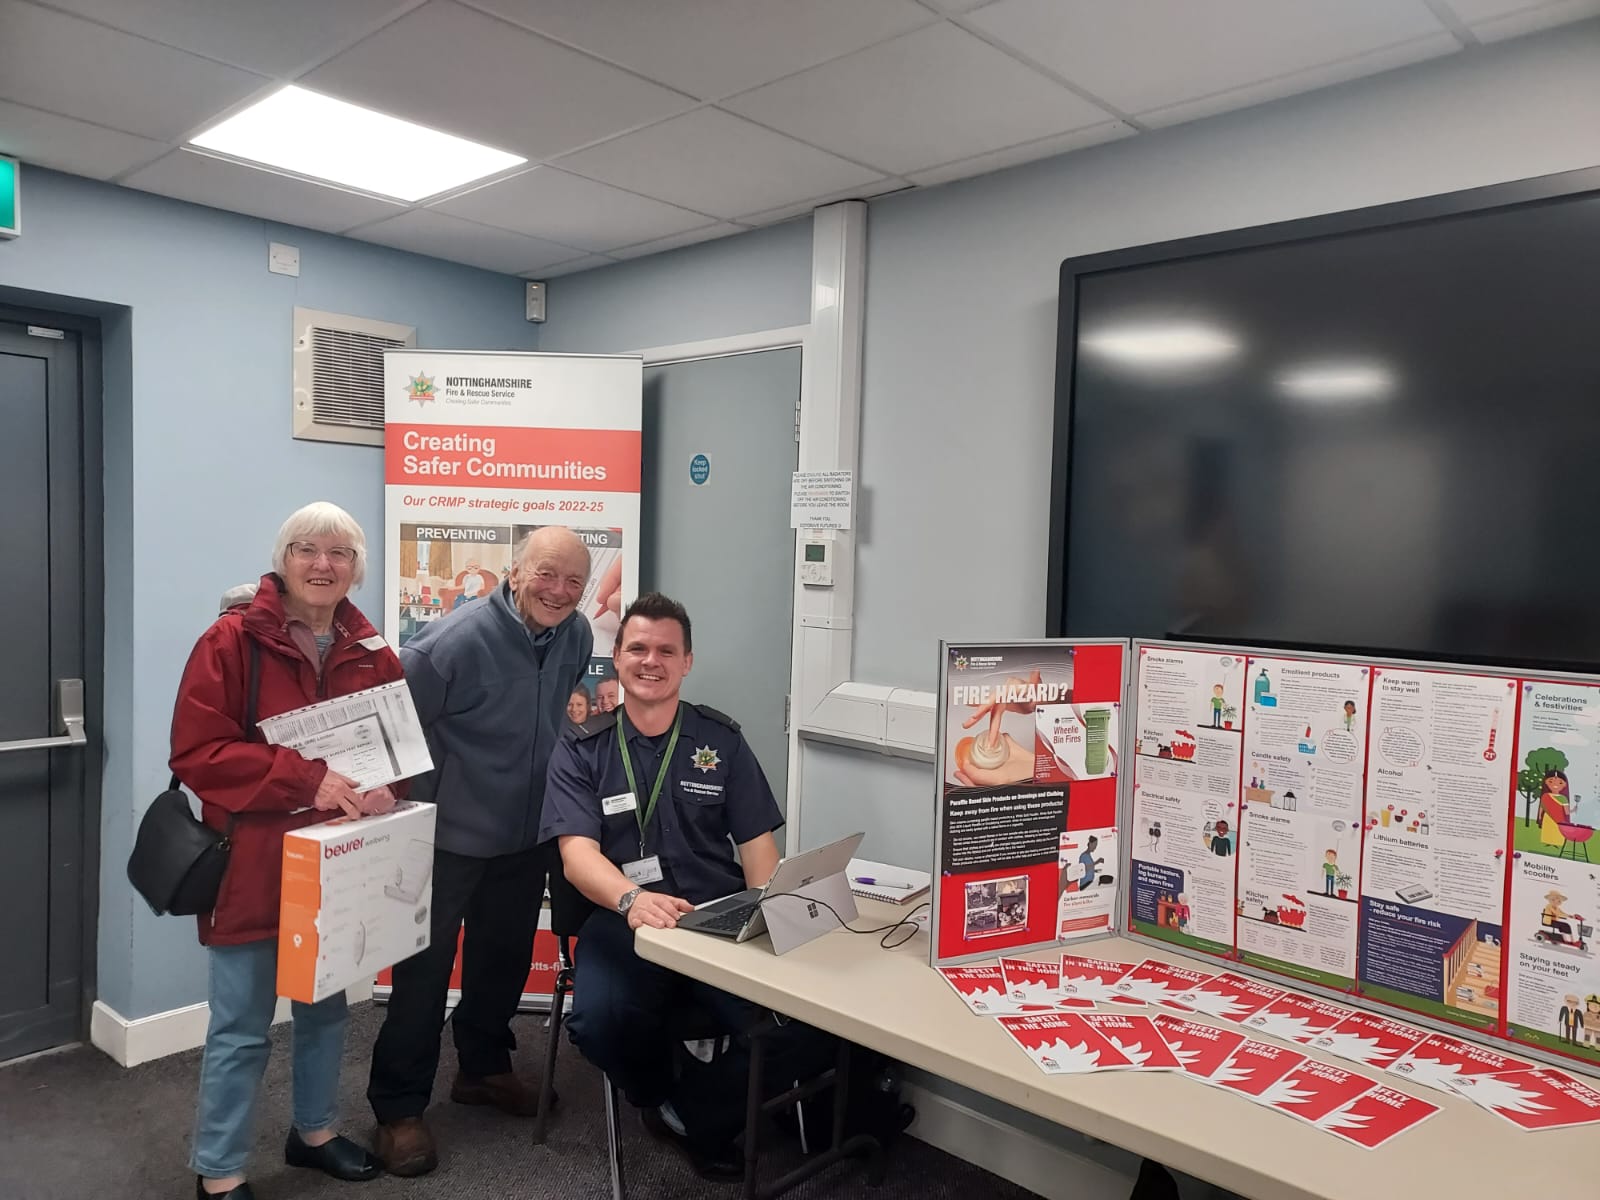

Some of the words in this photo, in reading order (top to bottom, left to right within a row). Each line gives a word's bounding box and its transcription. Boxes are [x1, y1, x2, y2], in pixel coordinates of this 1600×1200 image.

[446, 377, 532, 389] NOTTINGHAMSHIRE
[491, 390, 515, 398] Service
[403, 431, 496, 457] Creating
[403, 455, 461, 476] Safer
[466, 457, 607, 481] Communities
[403, 495, 425, 507] Our
[428, 495, 466, 508] CRMP
[468, 497, 520, 511] strategic
[522, 499, 555, 512] goals
[558, 500, 604, 512] 2022-25
[416, 527, 496, 541] PREVENTING
[1281, 668, 1311, 676] Emollient
[1311, 671, 1340, 679] products
[1383, 677, 1400, 687] Keep
[1401, 679, 1420, 687] warm
[953, 684, 990, 706] FIRE
[995, 682, 1069, 704] HAZARD?
[1390, 685, 1405, 694] stay
[1406, 686, 1420, 694] well
[1535, 693, 1587, 705] Celebrations
[1542, 702, 1583, 712] festivities
[1053, 725, 1079, 735] Wheelie
[1143, 729, 1164, 737] Kitchen
[1053, 735, 1064, 744] Bin
[1065, 734, 1081, 743] Fires
[1251, 751, 1272, 760] Candle
[1273, 754, 1292, 763] safety
[1377, 767, 1403, 777] Alcohol
[1141, 791, 1164, 800] Electrical
[1165, 795, 1181, 804] safety
[1249, 811, 1269, 821] Smoke
[1270, 814, 1291, 824] alarms
[324, 837, 364, 859] beurer
[1373, 833, 1398, 844] Lithium
[1399, 837, 1429, 850] batteries
[1523, 860, 1556, 873] Mobility
[1523, 869, 1559, 881] scooters
[1246, 890, 1269, 900] Kitchen
[1369, 900, 1384, 910] Stay
[1385, 904, 1400, 912] safe
[1372, 908, 1396, 918] reduce
[1414, 916, 1427, 925] fire
[1427, 920, 1441, 928] risk
[1025, 961, 1059, 970] SAFETY
[1087, 958, 1120, 967] SAFETY
[1097, 964, 1124, 974] HOME
[1519, 952, 1551, 967] Staying
[1552, 959, 1581, 974] steady
[1019, 965, 1036, 973] THE
[1037, 967, 1059, 975] HOM
[1155, 967, 1172, 976] THE
[1173, 972, 1201, 983] HOME
[1167, 965, 1203, 978] SAFETY
[1519, 961, 1529, 969] on
[1531, 965, 1551, 974] your
[1553, 969, 1569, 978] feet
[1231, 980, 1249, 990] THE
[1249, 987, 1277, 1000] HOME
[1243, 980, 1283, 995] SAFETY
[1282, 996, 1295, 1004] IN
[1297, 1000, 1315, 1010] THE
[1317, 1007, 1346, 1020] HOME
[1311, 1000, 1351, 1015] SAFETY
[1024, 1014, 1062, 1023] SAFETY
[1089, 1015, 1128, 1023] SAFETY
[1104, 1021, 1136, 1029] HOME
[1007, 1023, 1021, 1031] IN
[1022, 1022, 1042, 1030] THE
[1040, 1020, 1072, 1029] HOME
[1182, 1021, 1222, 1035] SAFETY
[1364, 1020, 1385, 1030] THE
[1387, 1028, 1419, 1042] HOME
[1380, 1019, 1422, 1036] SAFETY
[1167, 1023, 1187, 1034] THE
[1188, 1029, 1221, 1042] HOME
[1245, 1047, 1280, 1061] HOME
[1427, 1039, 1442, 1047] IN
[1443, 1043, 1466, 1056] THE
[1467, 1052, 1506, 1069] HOME
[1460, 1043, 1507, 1062] SAFETY
[1307, 1061, 1352, 1079] SAFETY
[1313, 1070, 1348, 1085] HOME
[1375, 1086, 1411, 1102] FETY
[1528, 1070, 1547, 1078] IN
[1542, 1077, 1569, 1090] THE
[1563, 1089, 1600, 1108] HOME
[1566, 1081, 1600, 1101] SAFET
